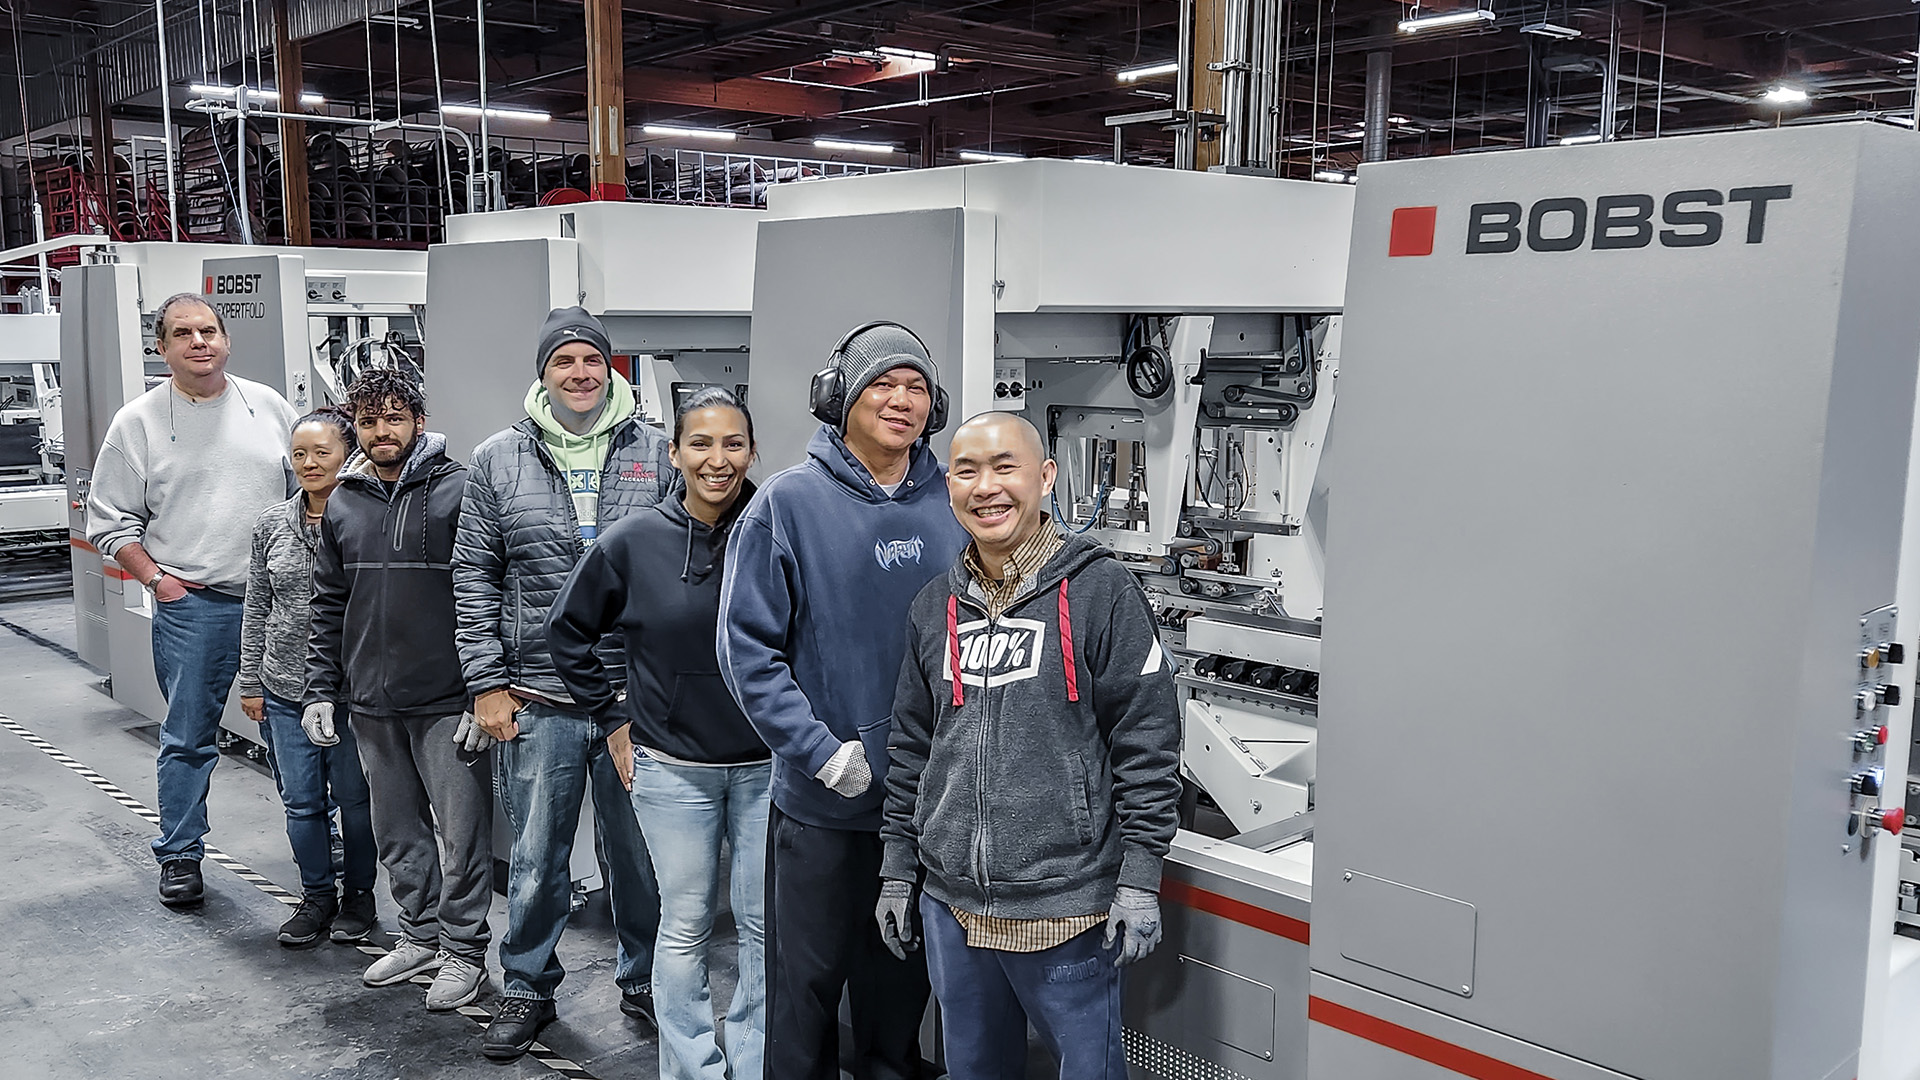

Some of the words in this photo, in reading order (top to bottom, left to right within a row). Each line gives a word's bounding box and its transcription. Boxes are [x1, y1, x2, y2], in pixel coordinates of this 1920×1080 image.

[1465, 184, 1793, 255] BOBST
[216, 274, 262, 295] BOBST
[959, 631, 1031, 670] 100%
